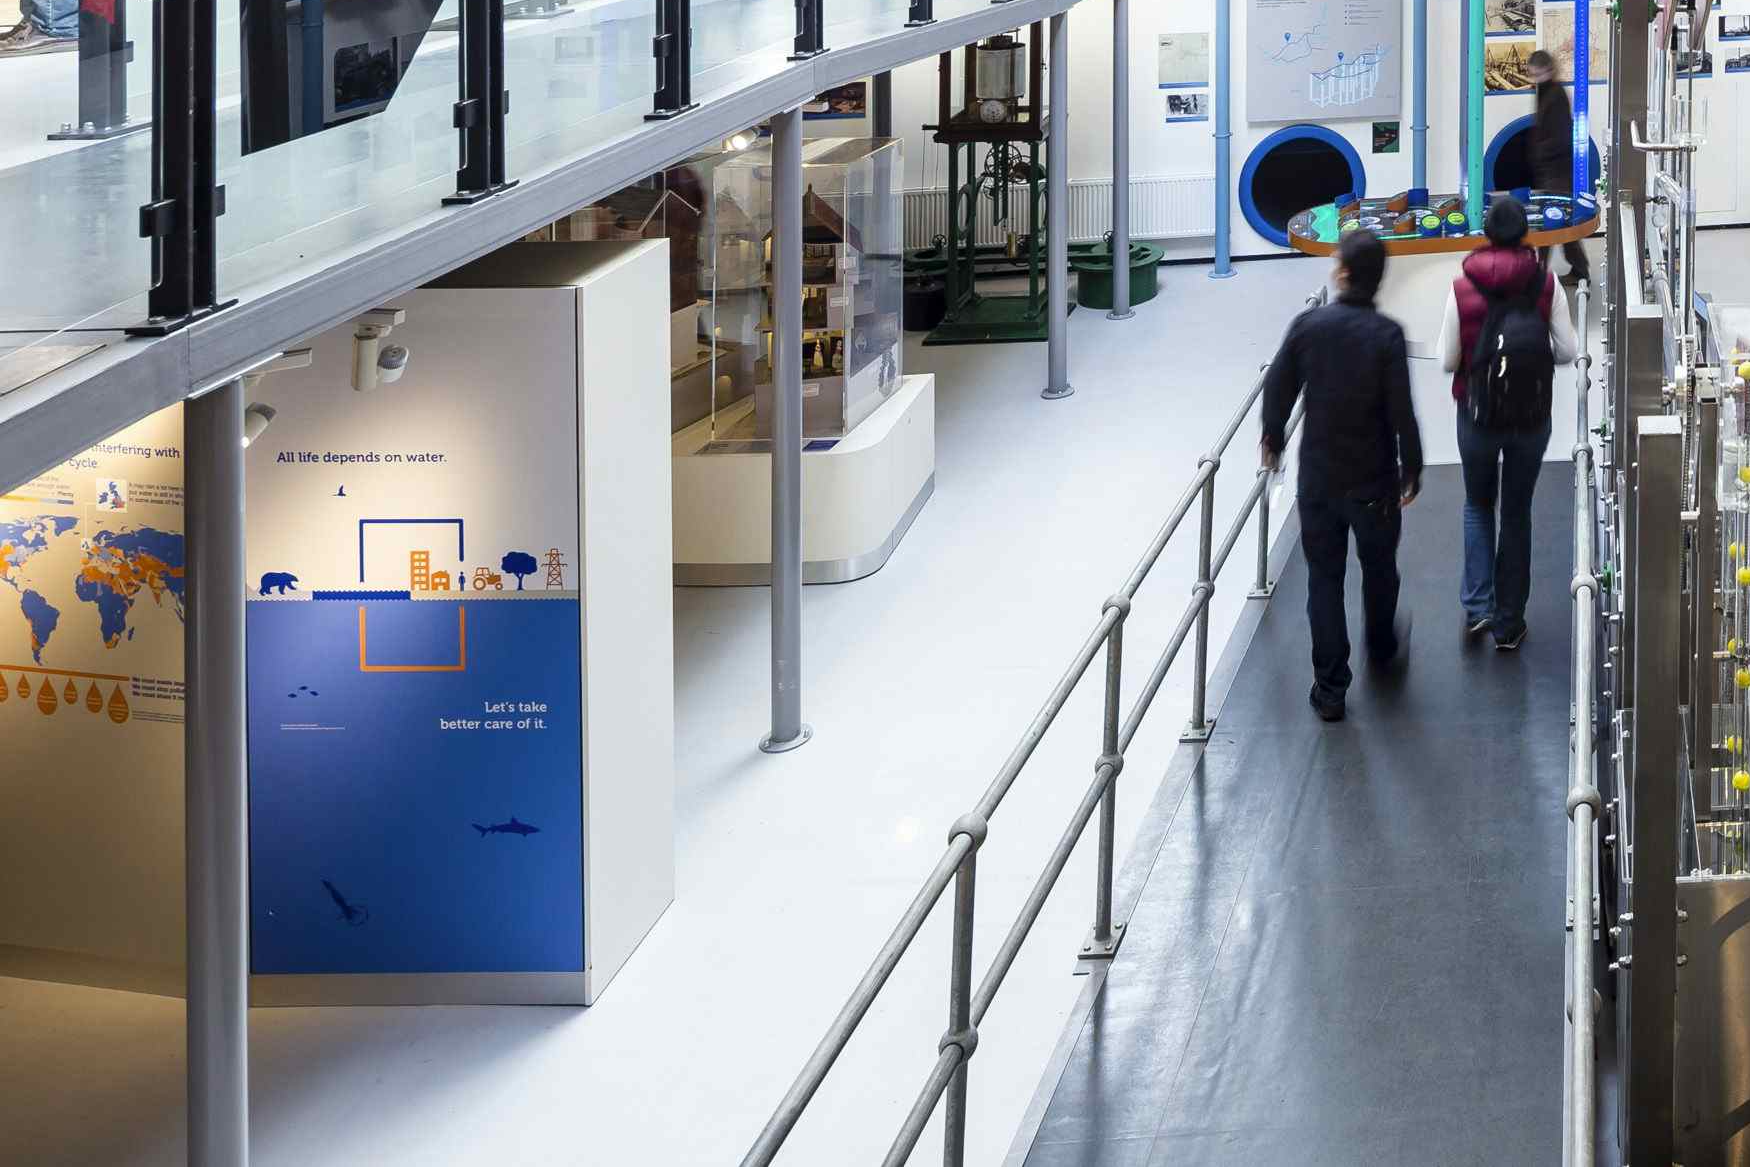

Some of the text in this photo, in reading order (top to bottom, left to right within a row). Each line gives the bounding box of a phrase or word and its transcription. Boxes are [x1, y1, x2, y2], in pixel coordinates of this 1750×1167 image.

[154, 446, 180, 459] with
[276, 452, 448, 465] All life depends on water.
[68, 457, 98, 470] cycle
[484, 701, 548, 714] Let's take
[440, 718, 548, 730] better care of it.
